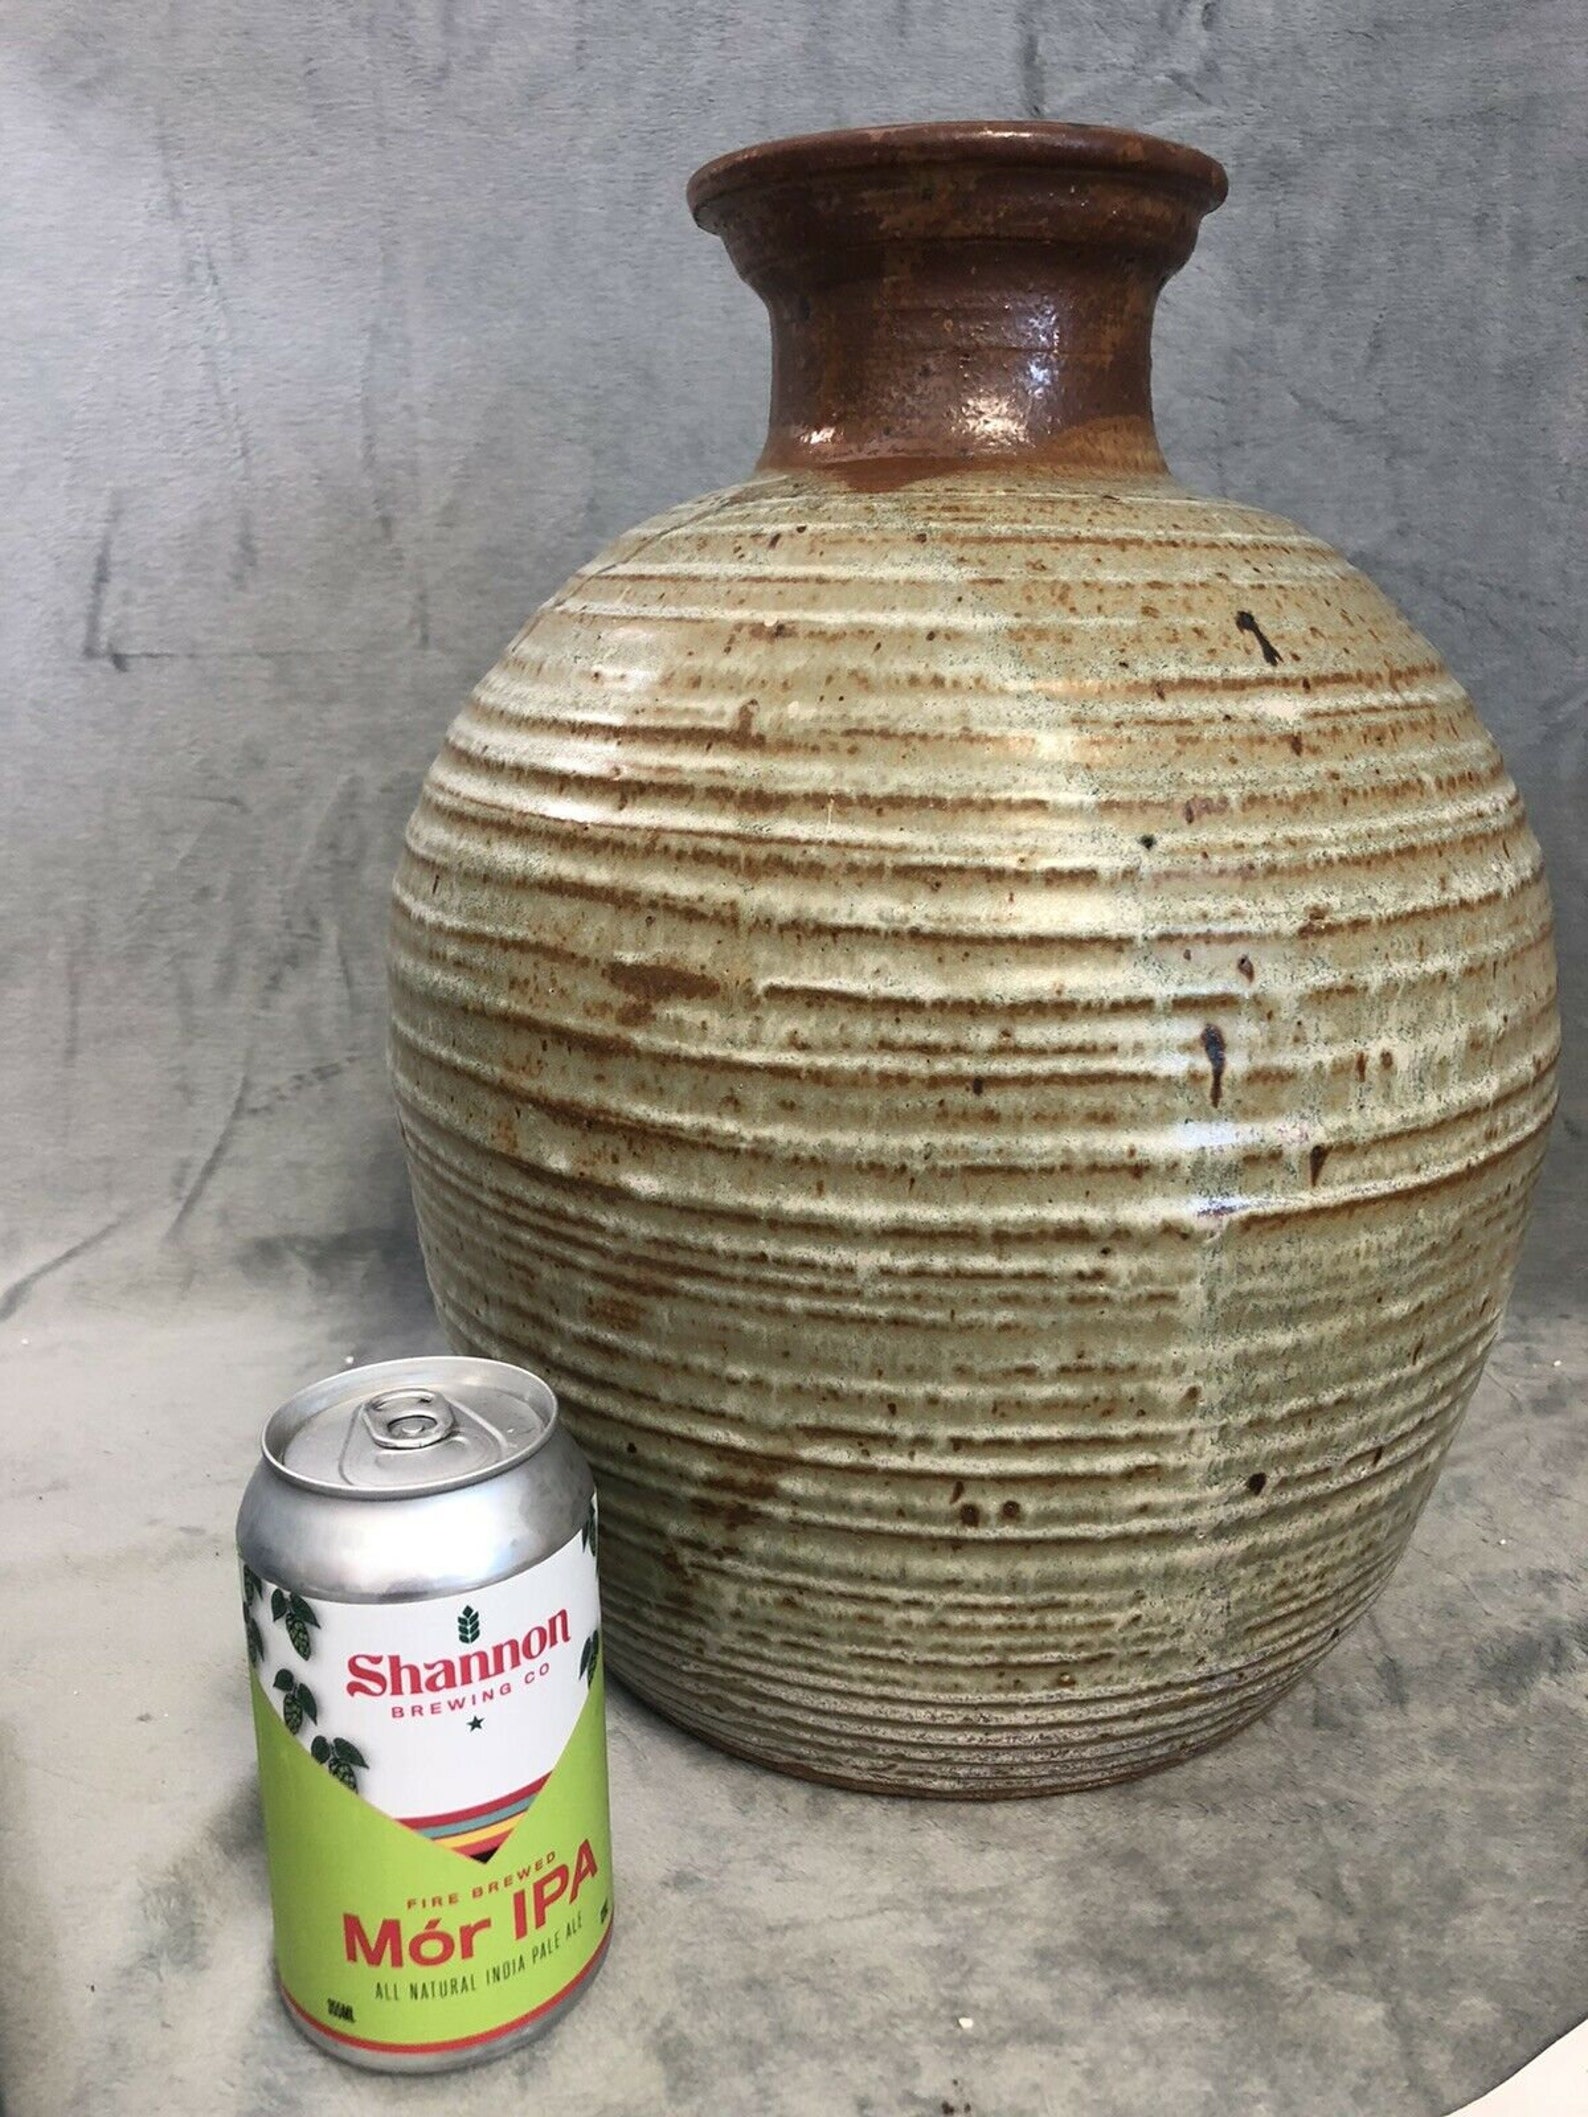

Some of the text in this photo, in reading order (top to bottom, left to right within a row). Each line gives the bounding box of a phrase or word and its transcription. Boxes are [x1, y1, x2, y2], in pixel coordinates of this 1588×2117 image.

[346, 1608, 571, 1697] Shannon
[391, 1662, 550, 1718] BREWING CO
[342, 1838, 598, 1969] Mór IPA
[407, 1851, 556, 1909] FIRE BREWED
[375, 1982, 399, 2001] ALL
[409, 1974, 476, 2001] NATURAL
[486, 1954, 525, 1986] INDIA
[532, 1930, 560, 1964] PALE
[566, 1910, 582, 1940] ALE
